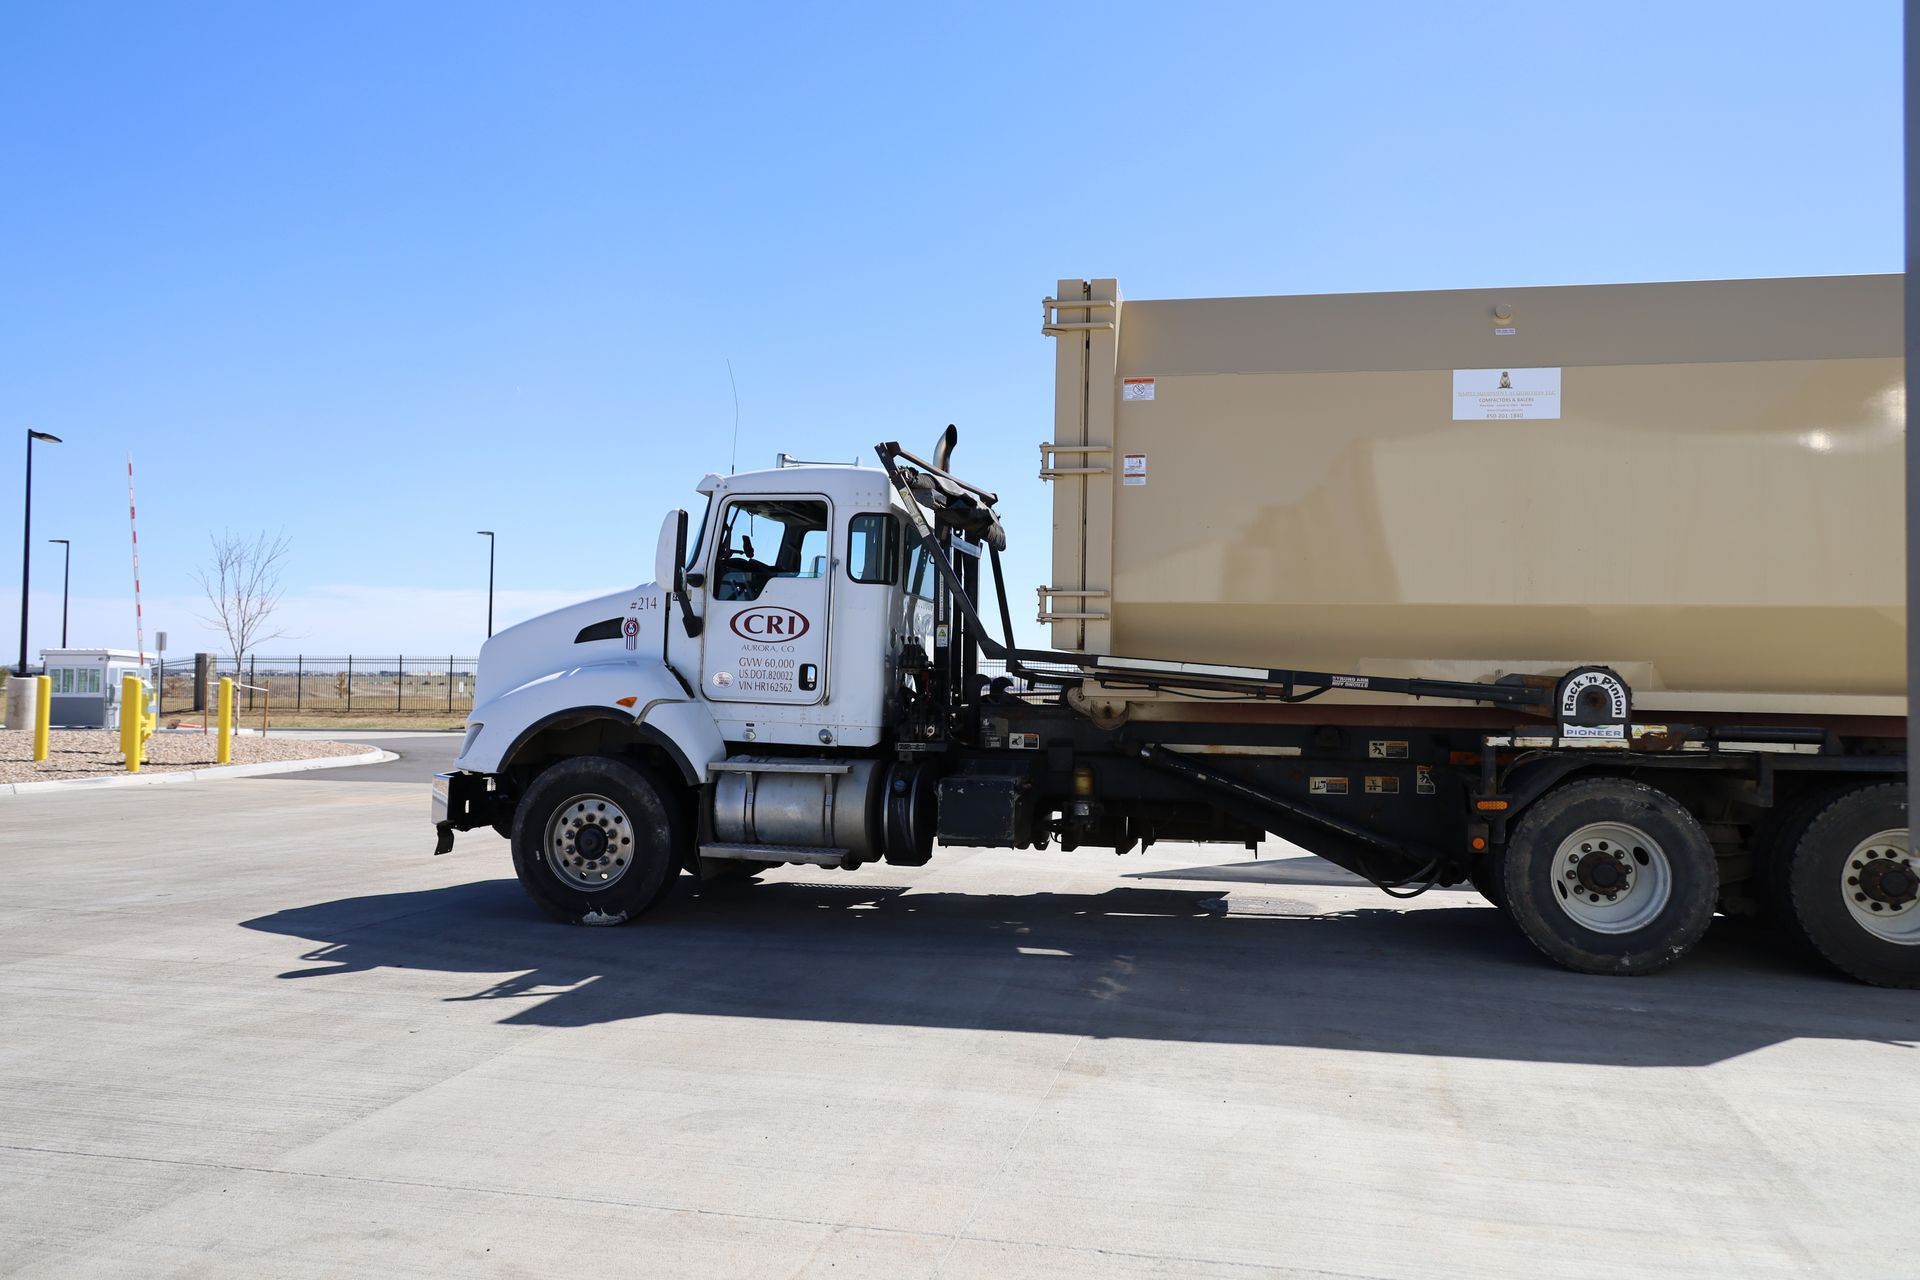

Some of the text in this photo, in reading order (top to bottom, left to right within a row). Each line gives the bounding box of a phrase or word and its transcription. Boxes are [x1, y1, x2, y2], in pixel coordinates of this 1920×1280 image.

[630, 597, 657, 610] #214
[743, 614, 795, 635] CRI
[738, 657, 795, 669] GVW 60,000
[738, 681, 793, 693] VIN HR162562
[1564, 679, 1584, 712] Rack
[1601, 676, 1624, 716] Pinion
[1566, 729, 1621, 737] PIONEER
